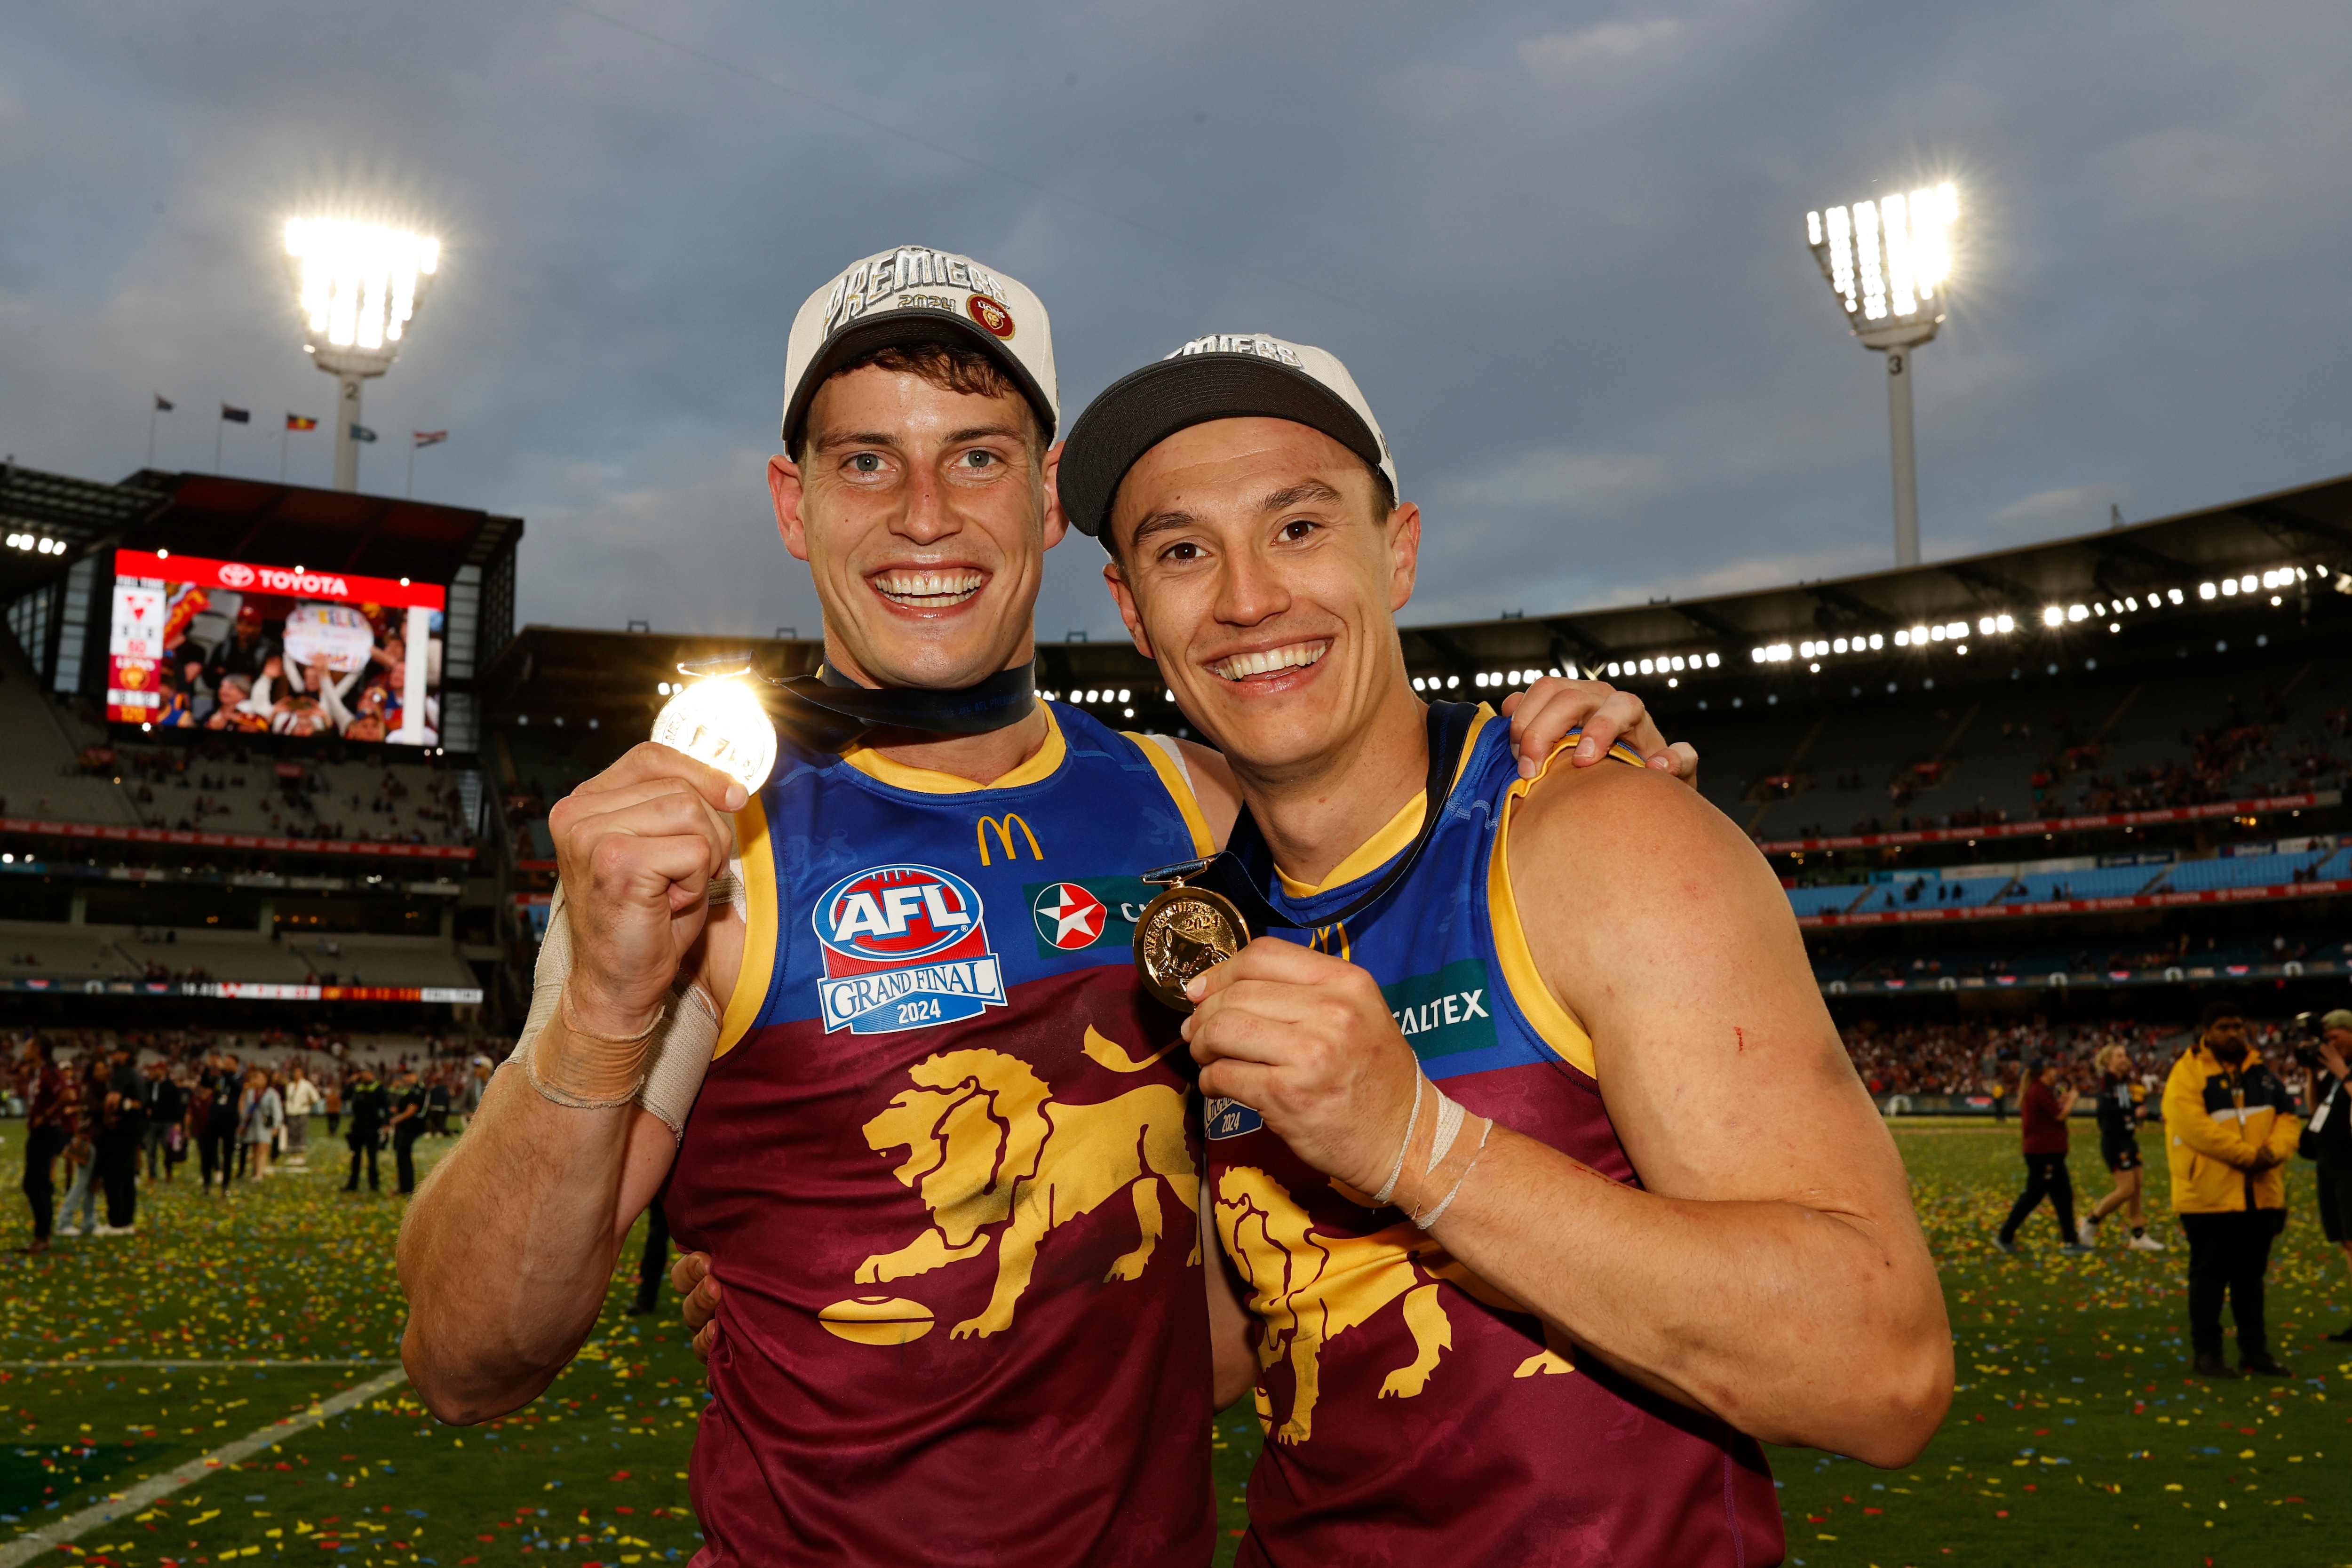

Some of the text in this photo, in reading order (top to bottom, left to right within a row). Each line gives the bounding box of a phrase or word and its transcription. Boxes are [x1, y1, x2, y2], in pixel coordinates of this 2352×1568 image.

[818, 248, 1010, 347] PREMIERS
[898, 294, 957, 313] 2024
[977, 301, 1006, 318] LIONS
[1888, 354, 1903, 376] 3
[344, 381, 360, 402] 2
[258, 569, 348, 596] TOYOTA
[833, 884, 972, 942] AFL
[1184, 914, 1221, 932] 2024
[830, 963, 996, 1019] GRAND FINAL
[897, 998, 941, 1024] 2024
[1222, 1112, 1241, 1133] 2024
